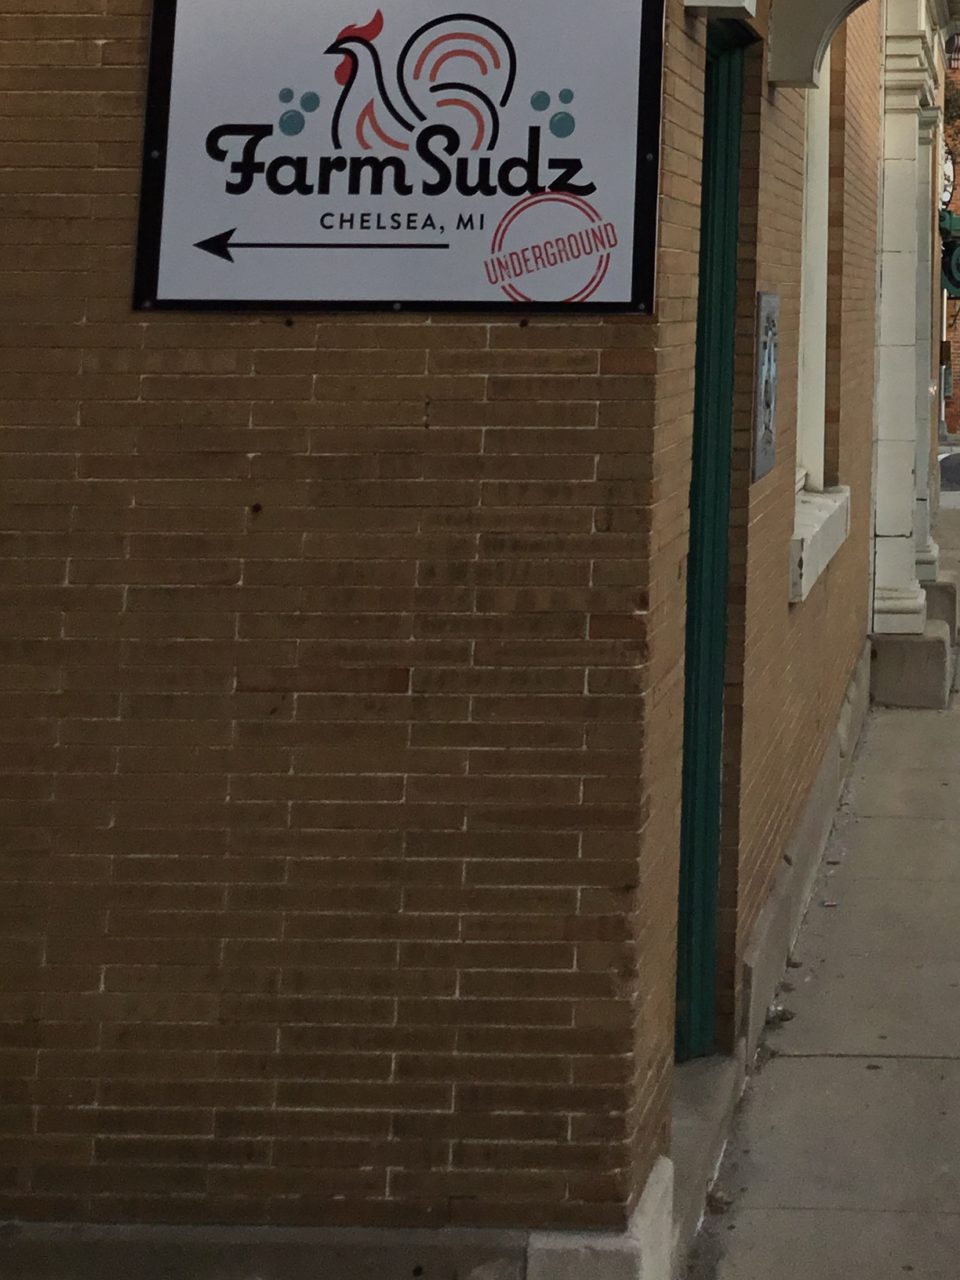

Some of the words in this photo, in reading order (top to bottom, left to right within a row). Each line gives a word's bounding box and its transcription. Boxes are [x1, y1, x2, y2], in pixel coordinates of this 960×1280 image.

[205, 123, 597, 197] FarmSudz
[319, 213, 445, 235] CHELSEA,
[456, 214, 485, 230] MI
[484, 222, 619, 287] UNDERGROUND
